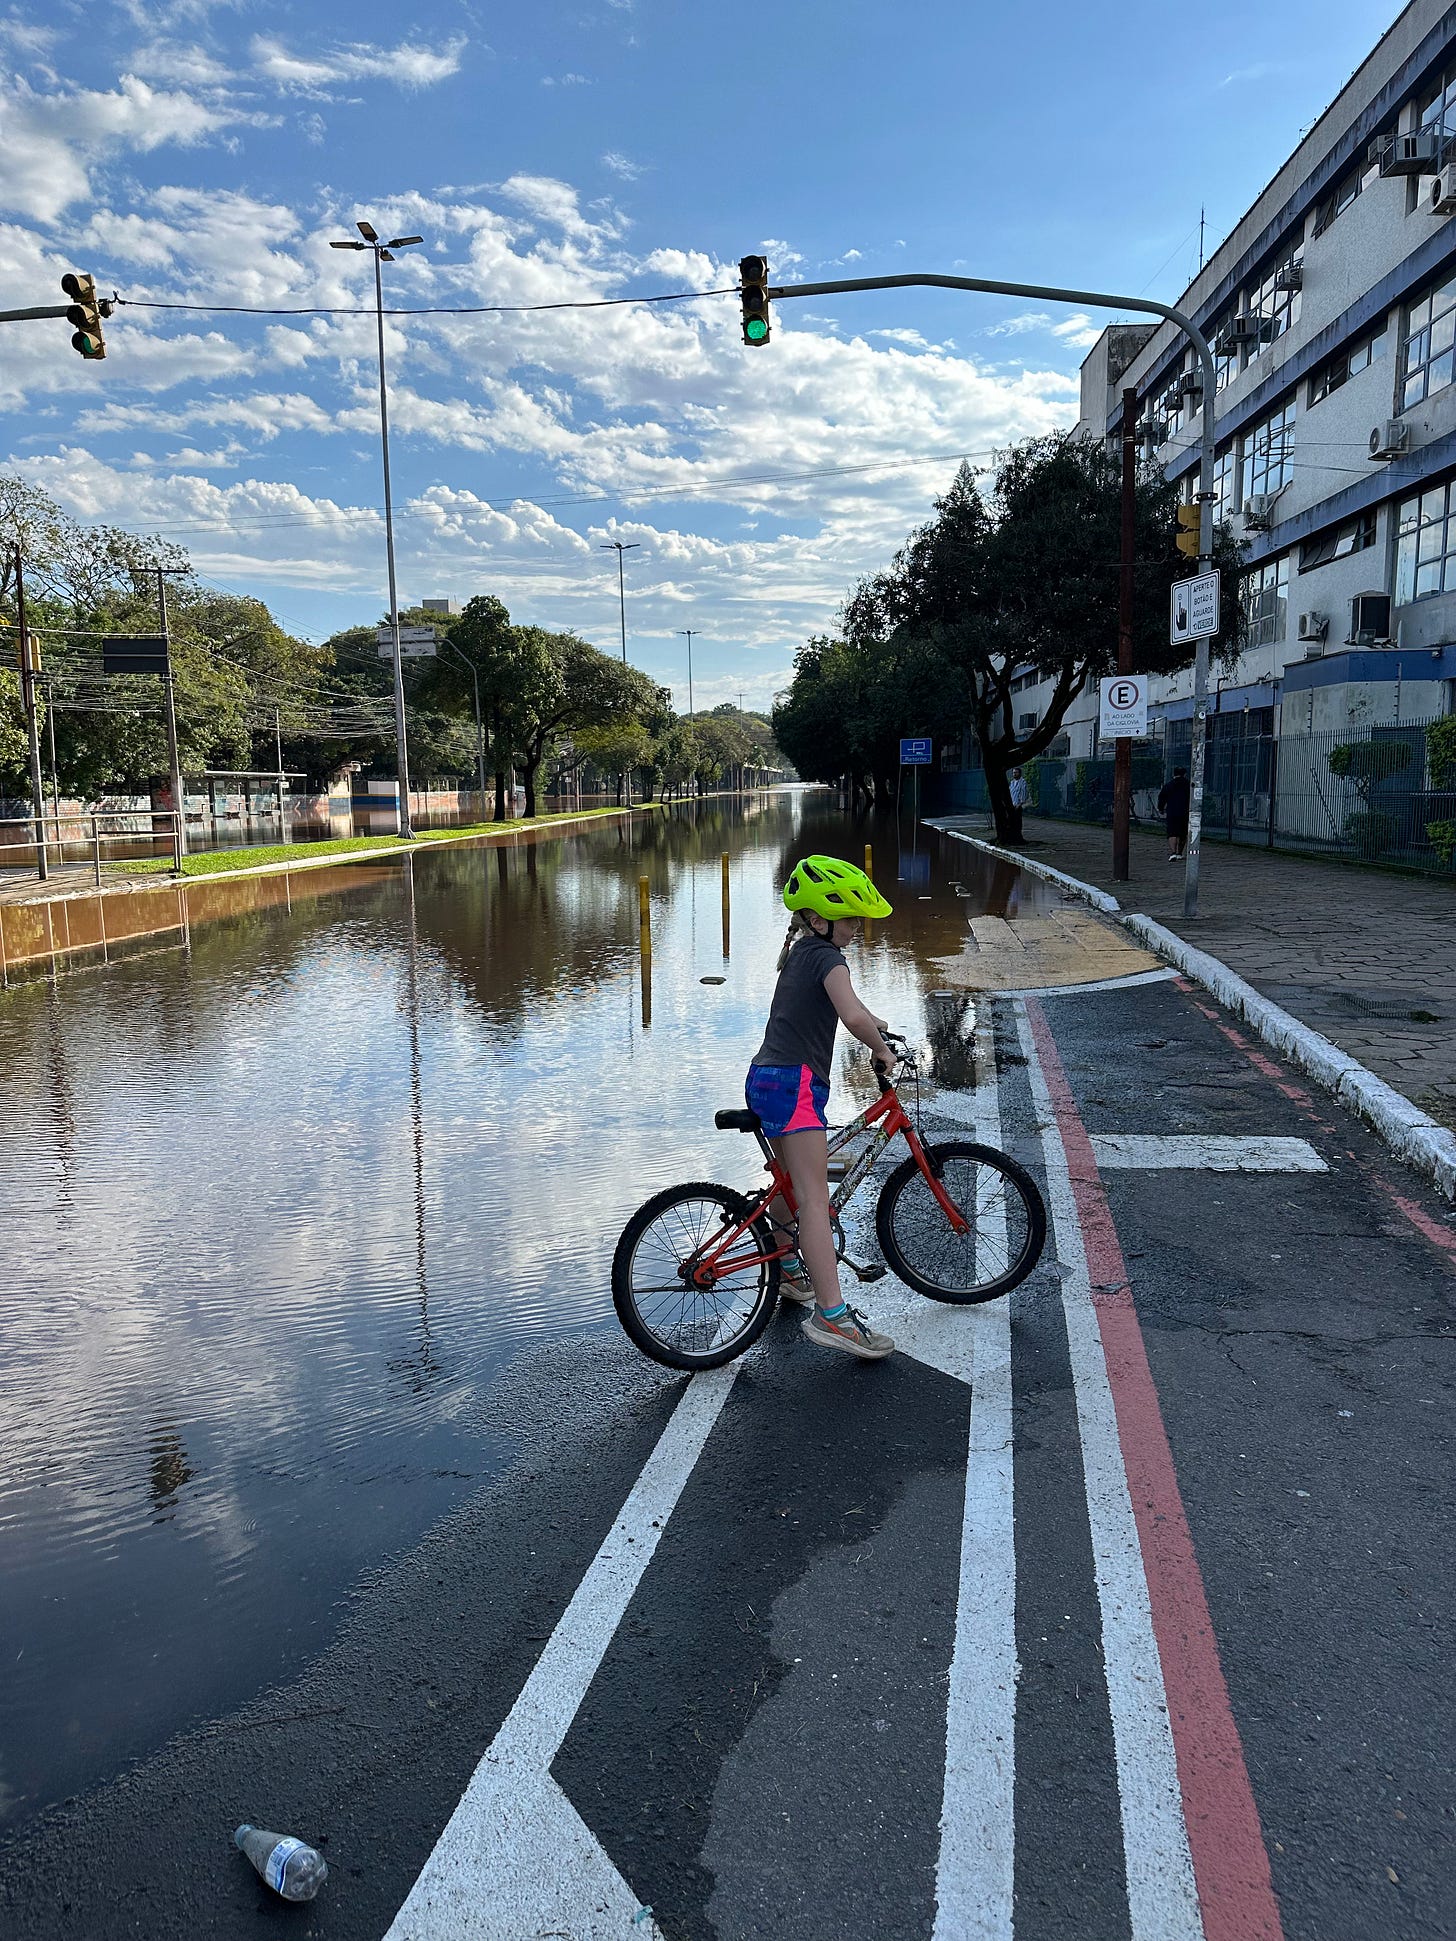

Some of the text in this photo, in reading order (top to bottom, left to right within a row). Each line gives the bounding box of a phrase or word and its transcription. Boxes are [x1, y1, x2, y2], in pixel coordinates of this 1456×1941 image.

[1193, 582, 1210, 592] APERTE
[1194, 594, 1210, 606] BOTÃO
[1193, 606, 1214, 618] AGUARDE
[1118, 686, 1128, 704] E
